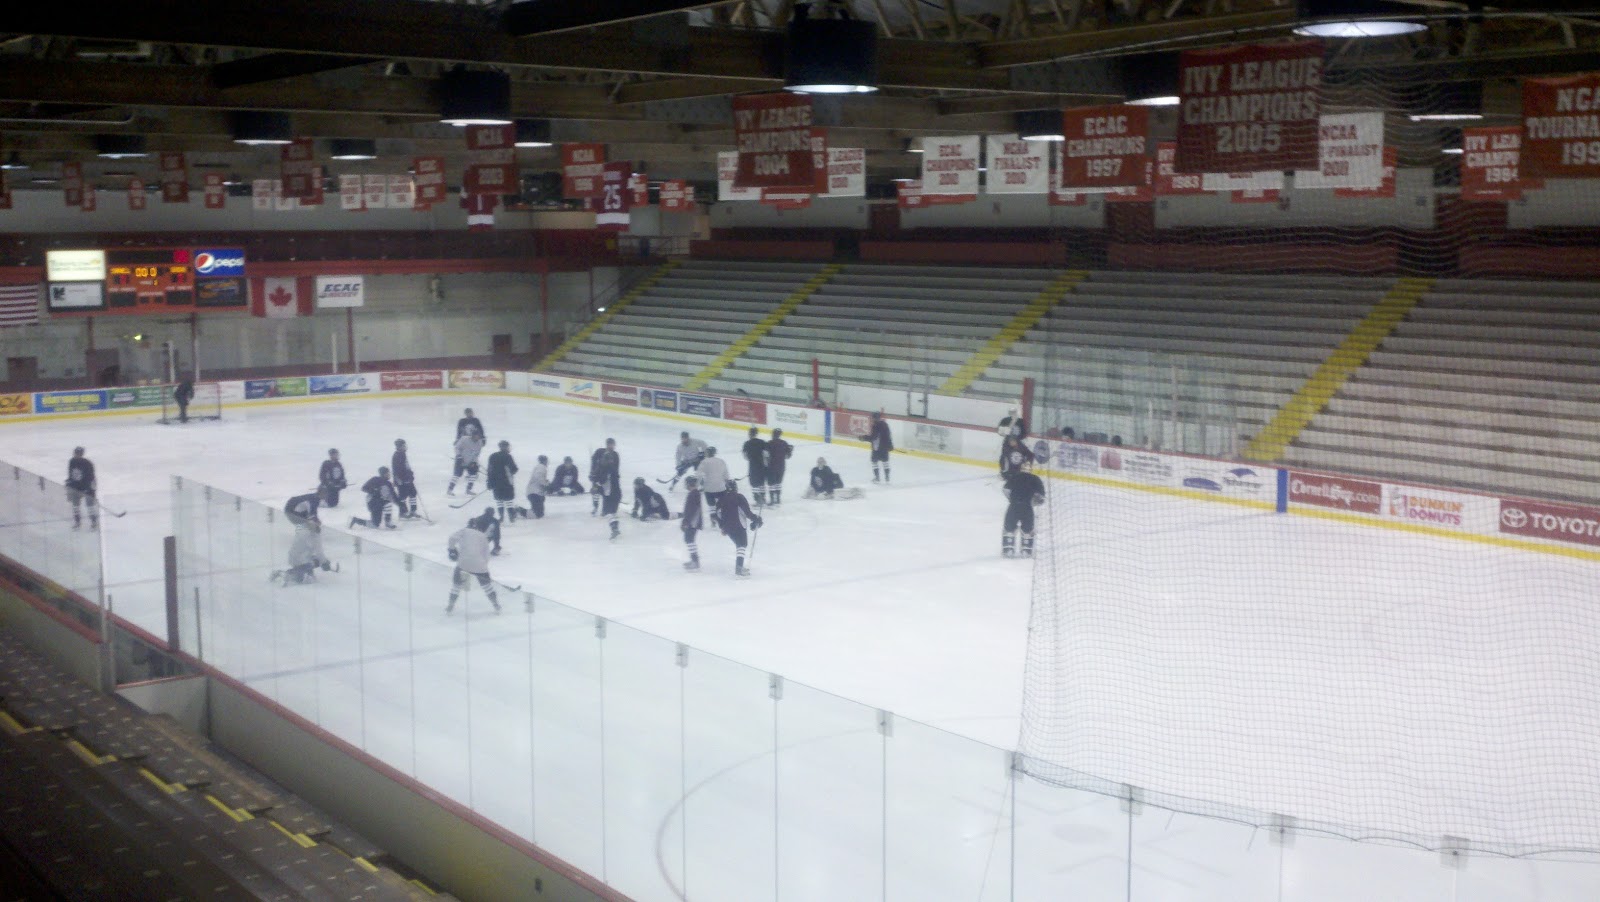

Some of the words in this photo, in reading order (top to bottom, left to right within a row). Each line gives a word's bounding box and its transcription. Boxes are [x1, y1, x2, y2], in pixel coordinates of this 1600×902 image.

[1184, 65, 1223, 94] IVY
[1230, 57, 1323, 91] LEAGUE
[760, 105, 811, 128] LEAGUE
[1184, 91, 1318, 125] CHAMPIONS
[1084, 115, 1128, 136] ECAC
[738, 130, 811, 153] CHAMPIONS
[1067, 136, 1146, 157] CHAMPIONS
[1216, 123, 1281, 152] 2005
[754, 154, 790, 175] 2004
[926, 158, 976, 172] CHAMPIONS
[995, 156, 1041, 170] FINALIST
[1086, 158, 1123, 177] 1997
[603, 184, 621, 209] 25
[214, 257, 244, 268] pepsi
[324, 283, 360, 292] ECAC
[1409, 508, 1462, 526] DONUTS
